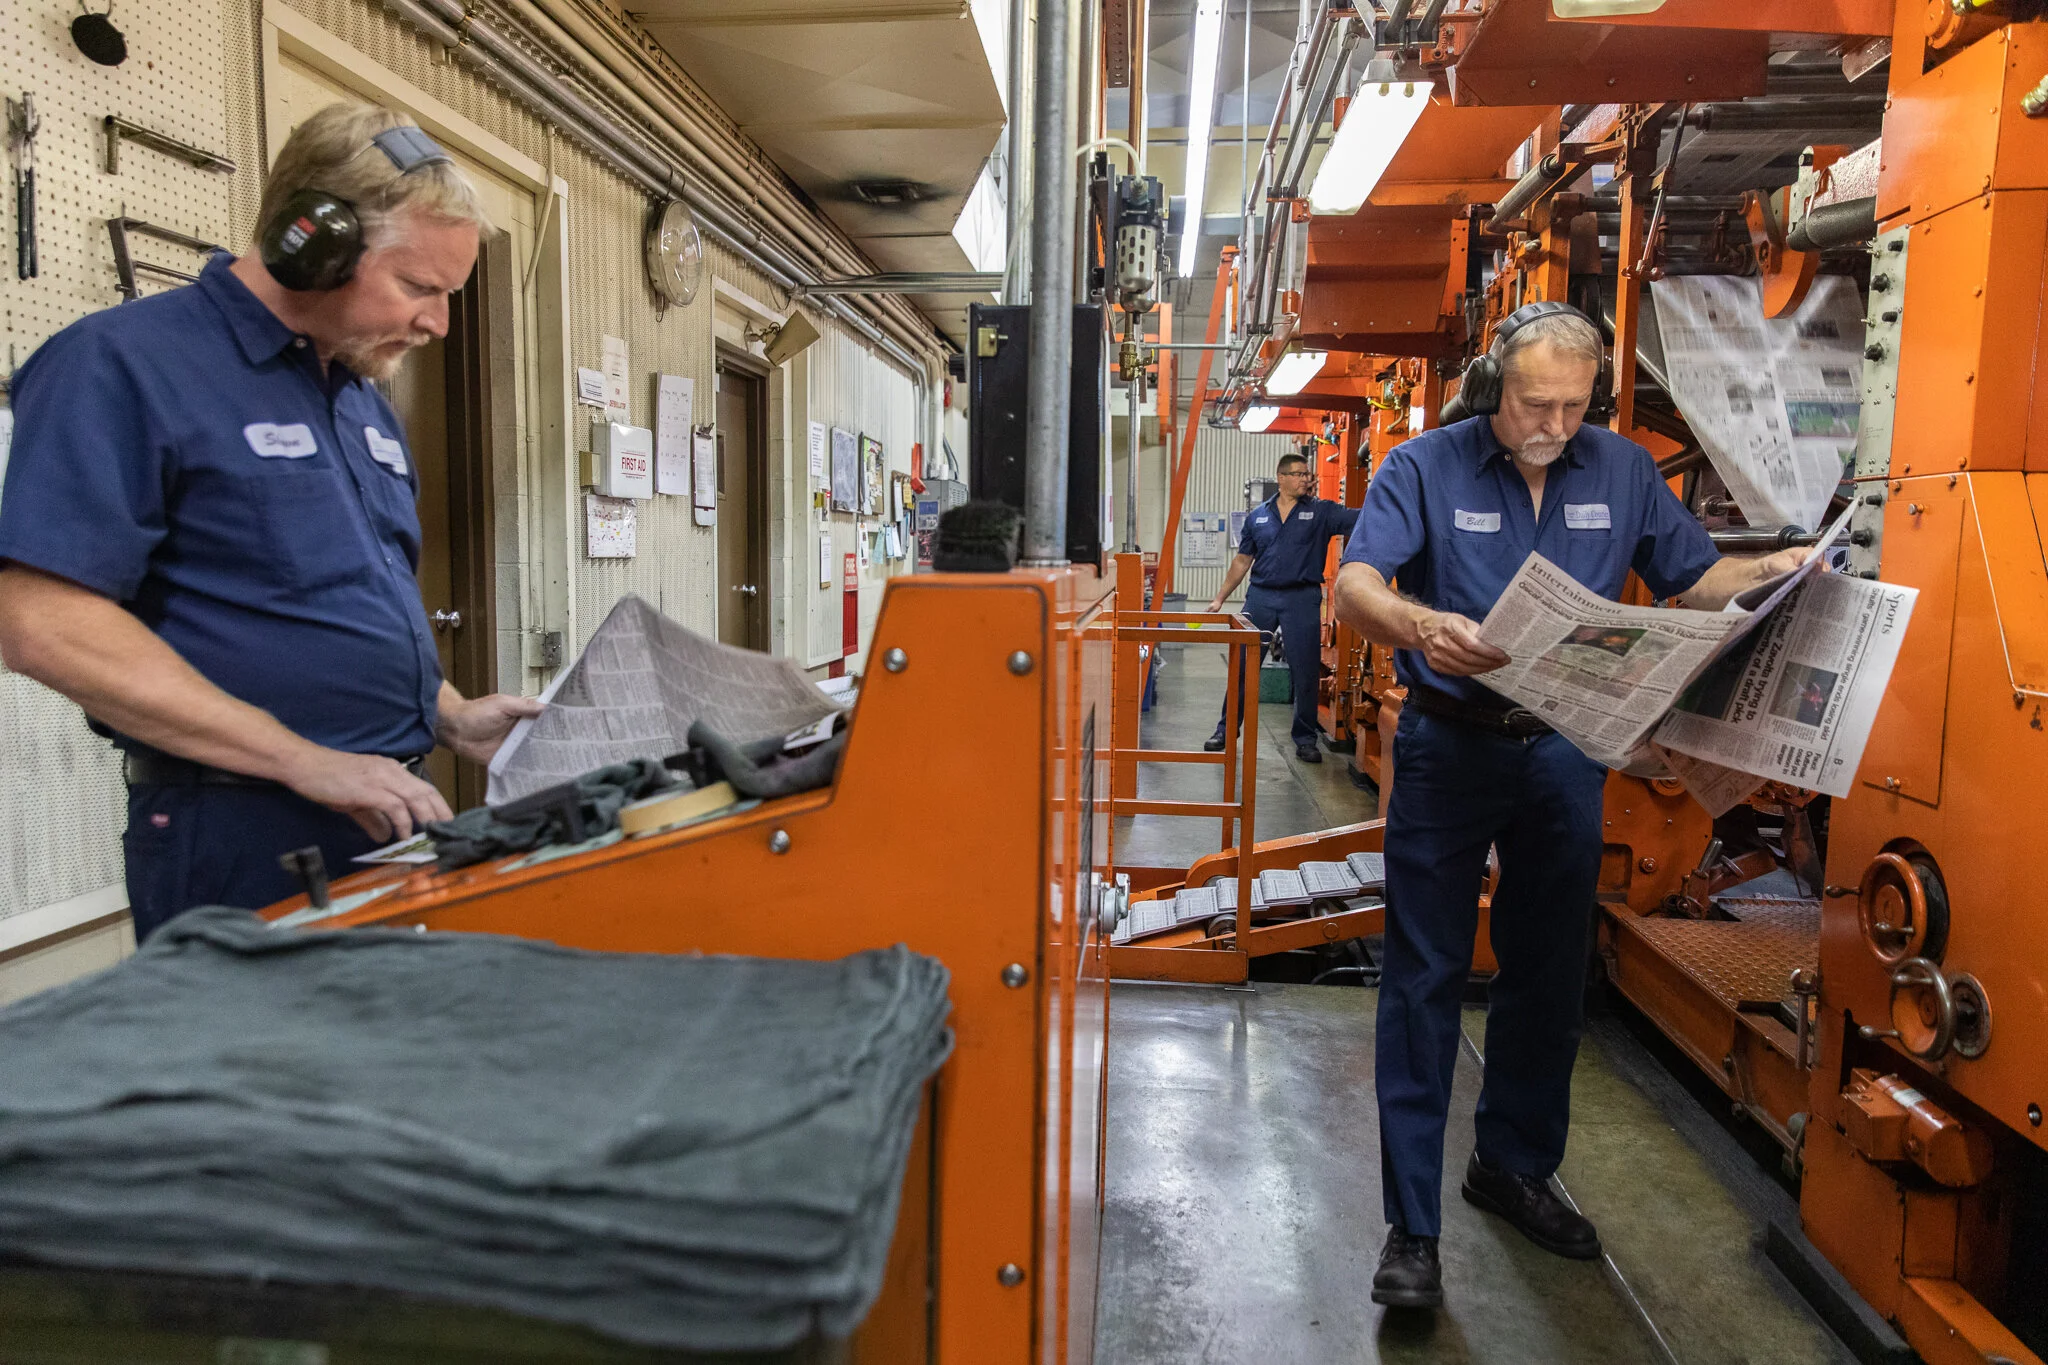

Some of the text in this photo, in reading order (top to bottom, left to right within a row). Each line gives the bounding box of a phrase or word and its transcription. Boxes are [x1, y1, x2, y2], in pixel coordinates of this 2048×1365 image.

[621, 457, 647, 472] FIRST AID
[1466, 516, 1486, 526] Bill
[845, 558, 856, 573] FIRE
[1530, 562, 1622, 615] Entertainment
[1881, 592, 1906, 635] Sports
[1847, 613, 1870, 662] game-winning
[1752, 658, 1761, 669] of
[1841, 662, 1853, 684] single
[1738, 678, 1754, 702] draft
[1748, 680, 1768, 710] trying
[1837, 684, 1846, 702] ends
[1730, 701, 1744, 724] pick
[1746, 711, 1757, 721] to
[1824, 703, 1840, 725] losing
[1820, 723, 1831, 741] skid
[1833, 757, 1844, 765] B
